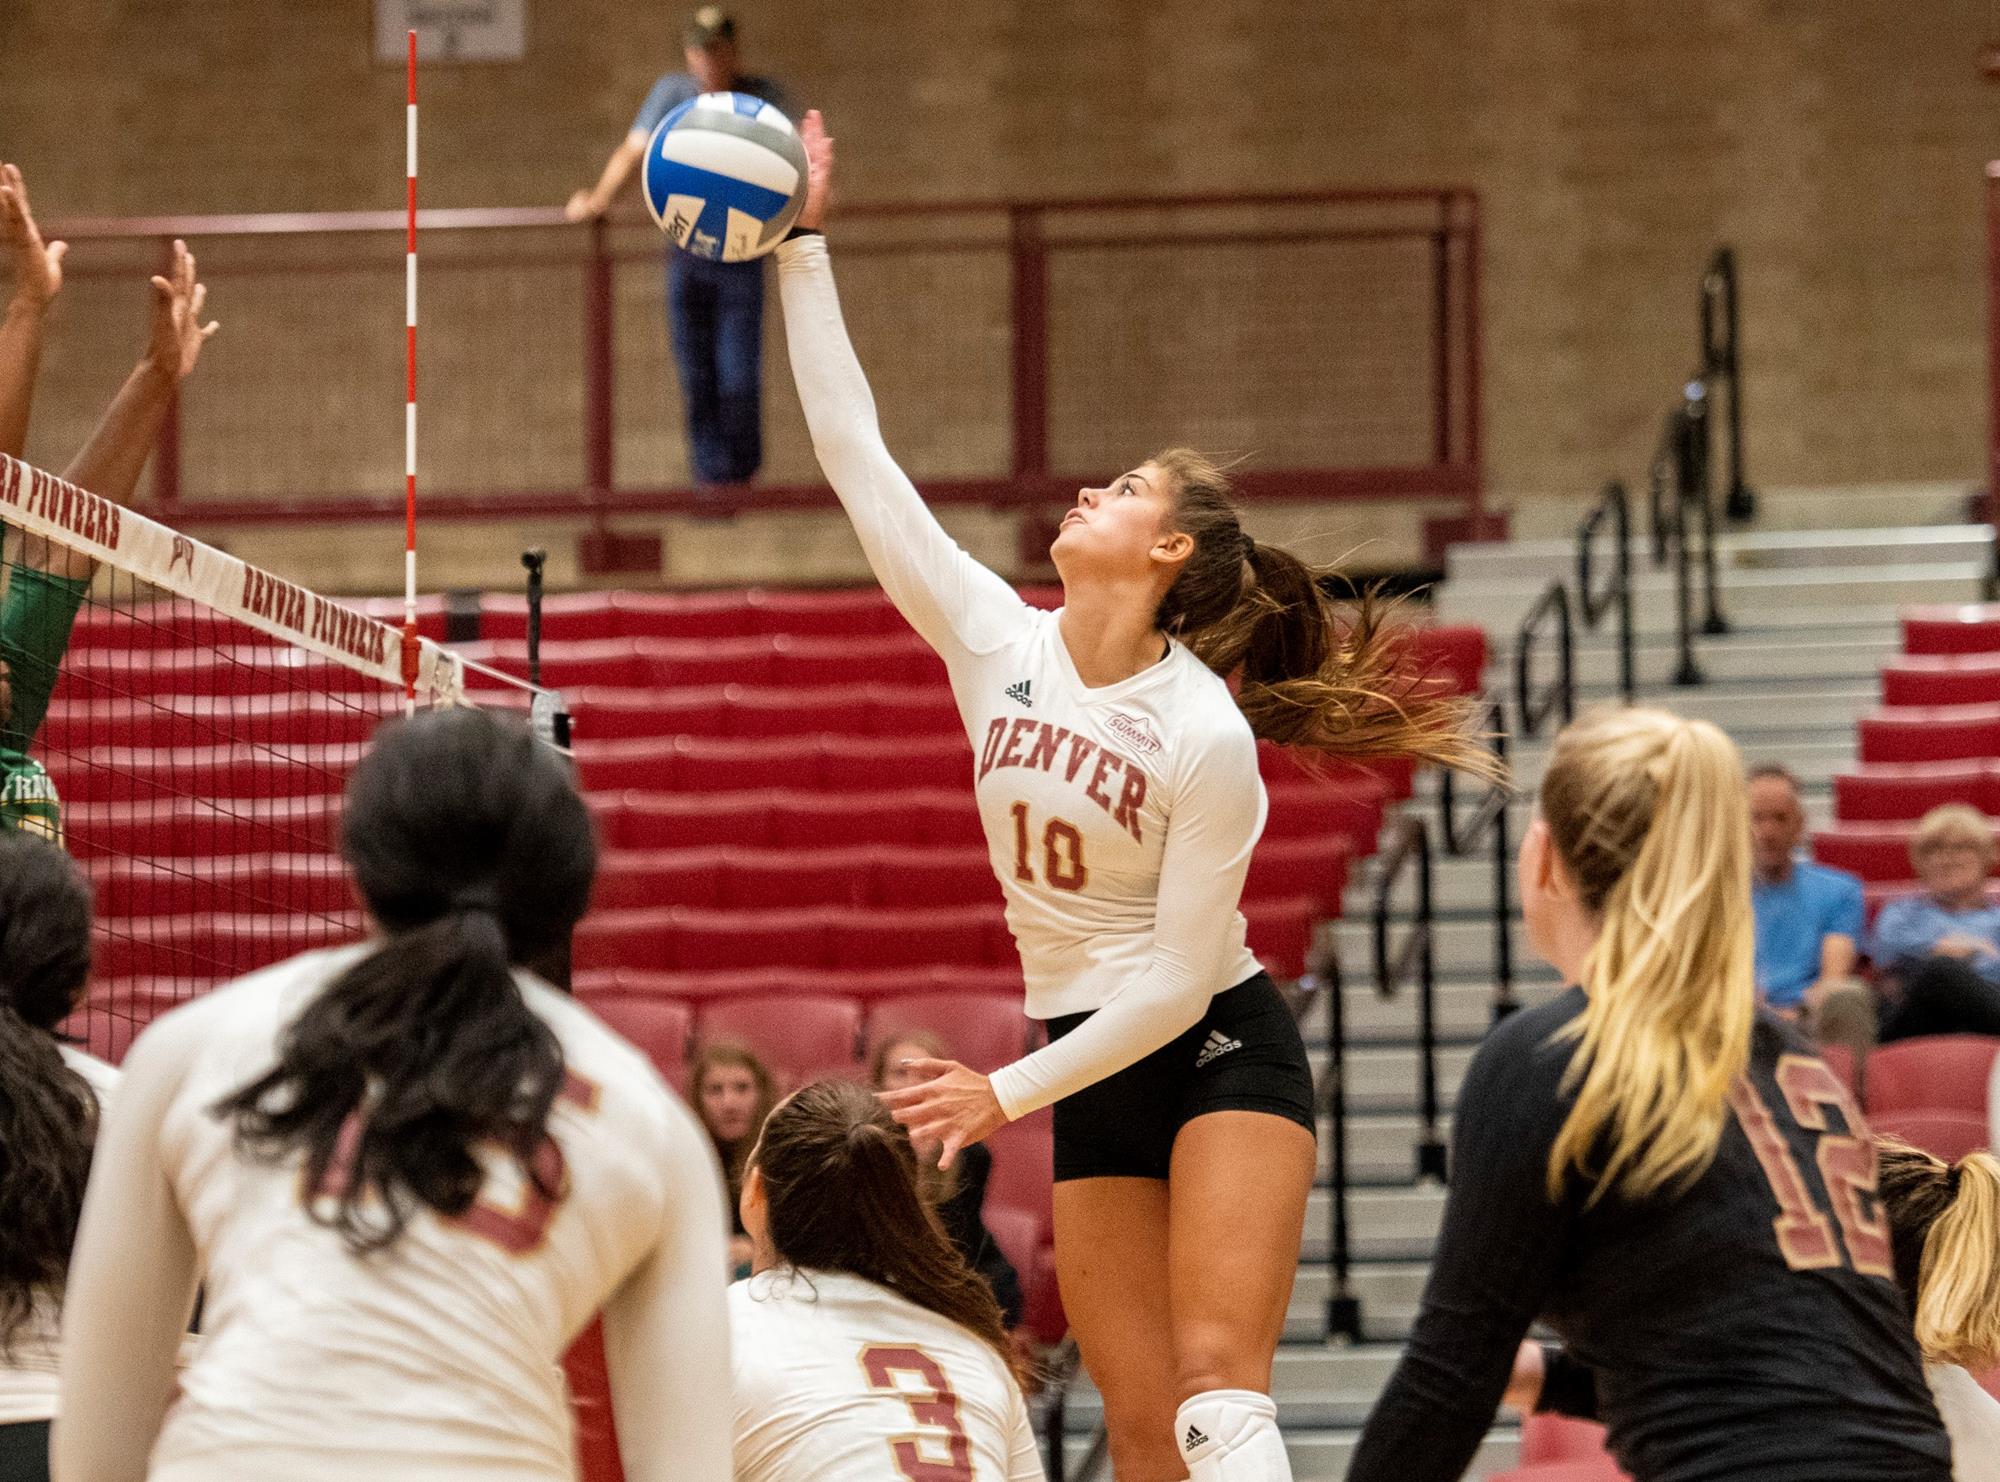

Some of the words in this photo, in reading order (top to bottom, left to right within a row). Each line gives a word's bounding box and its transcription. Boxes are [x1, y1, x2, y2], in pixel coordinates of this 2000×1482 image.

[26, 466, 121, 551] PIONEERS
[1005, 686, 1033, 708] adidas
[1109, 718, 1158, 751] SUMMIT
[978, 716, 1148, 845] DENVER
[1009, 799, 1089, 894] 10
[1196, 1039, 1243, 1068] adidas
[1725, 1053, 1894, 1279] 12
[856, 1342, 976, 1482] 3
[1186, 1434, 1210, 1453] adidas
